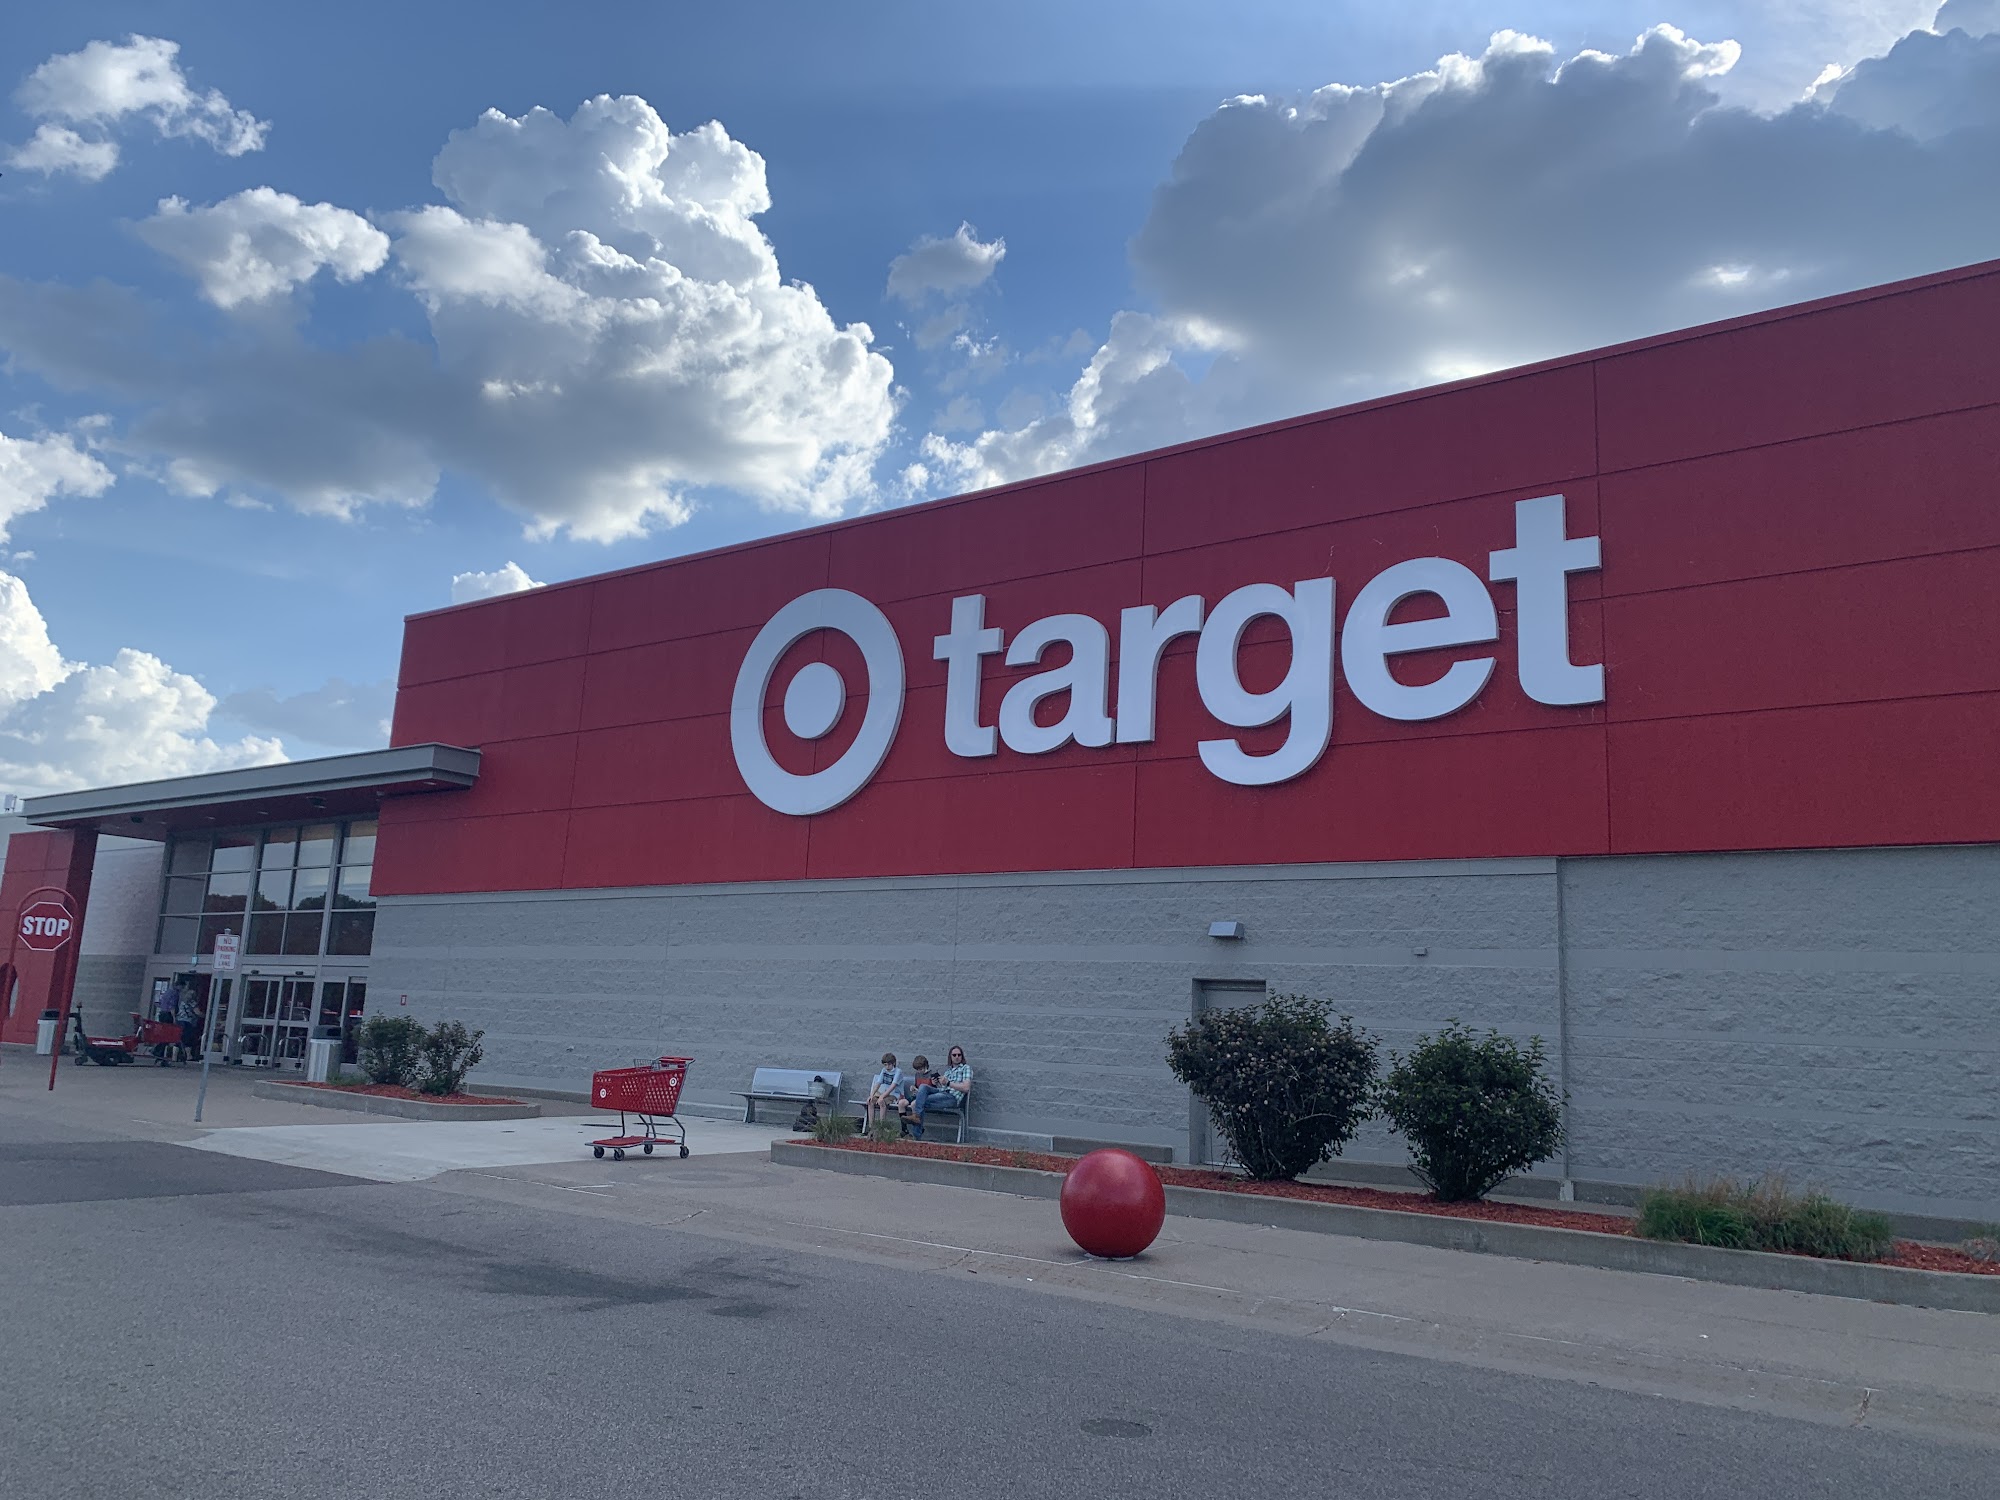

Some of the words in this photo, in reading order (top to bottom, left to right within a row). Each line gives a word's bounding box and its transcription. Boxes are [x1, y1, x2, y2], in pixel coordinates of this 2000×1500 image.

[933, 494, 1605, 786] target
[22, 916, 70, 937] STOP
[223, 937, 232, 945] NO
